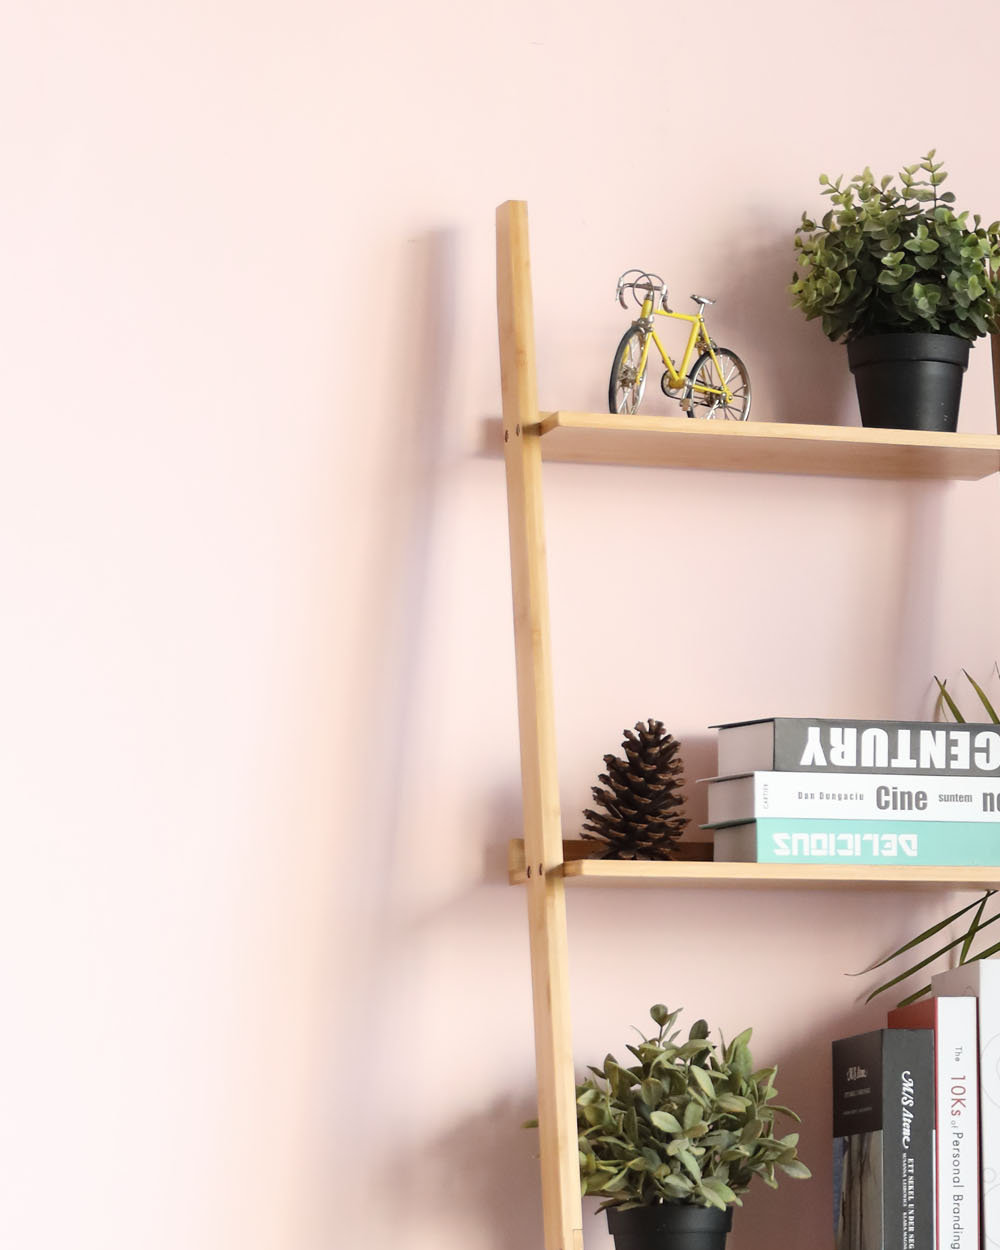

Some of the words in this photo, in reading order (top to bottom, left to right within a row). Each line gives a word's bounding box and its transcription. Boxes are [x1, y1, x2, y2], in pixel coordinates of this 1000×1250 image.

[797, 791, 815, 801] Dan
[876, 785, 928, 811] Cine
[938, 792, 973, 803] suntem
[772, 832, 919, 857] DELICIOUS
[954, 1046, 963, 1062] The
[951, 1075, 966, 1116] 10Ks
[902, 1107, 914, 1149] Atene
[951, 1119, 959, 1128] of
[952, 1132, 964, 1188] Personal
[907, 1176, 915, 1202] SEKEL
[951, 1194, 964, 1250] Branding
